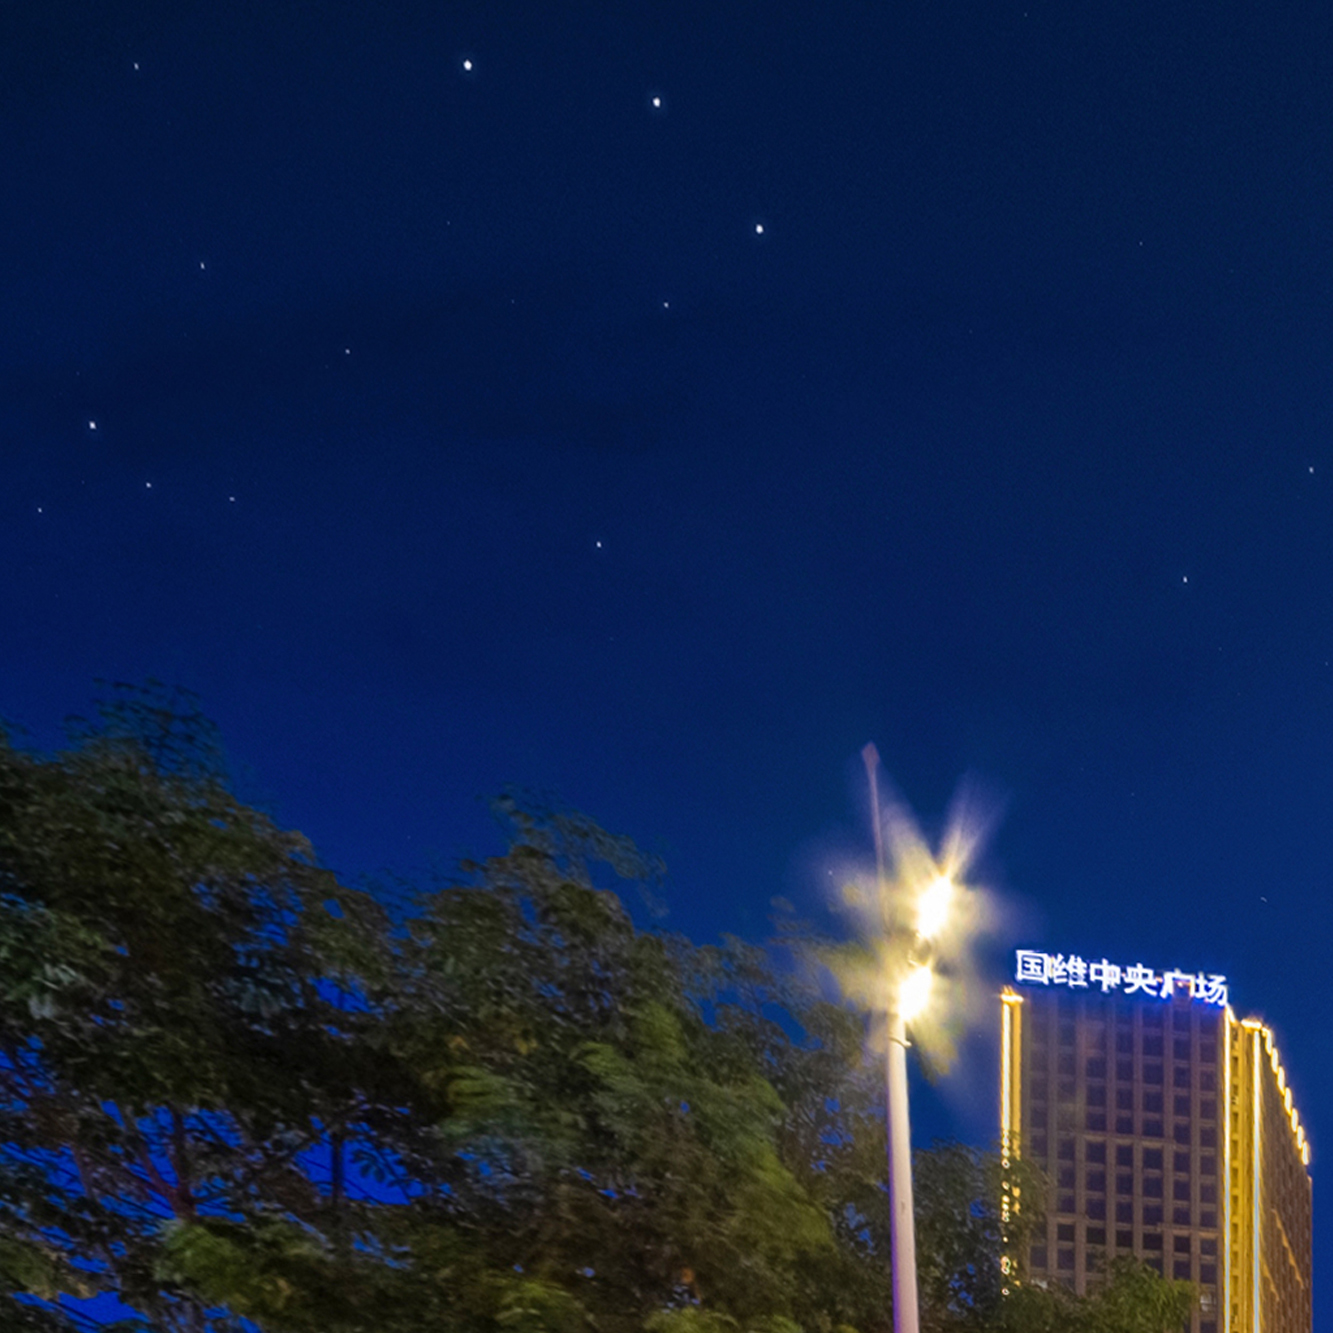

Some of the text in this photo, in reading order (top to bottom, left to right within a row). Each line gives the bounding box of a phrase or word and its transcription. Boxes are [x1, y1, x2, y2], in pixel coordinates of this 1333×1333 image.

[1014, 949, 1229, 1006] 国维中央广场
